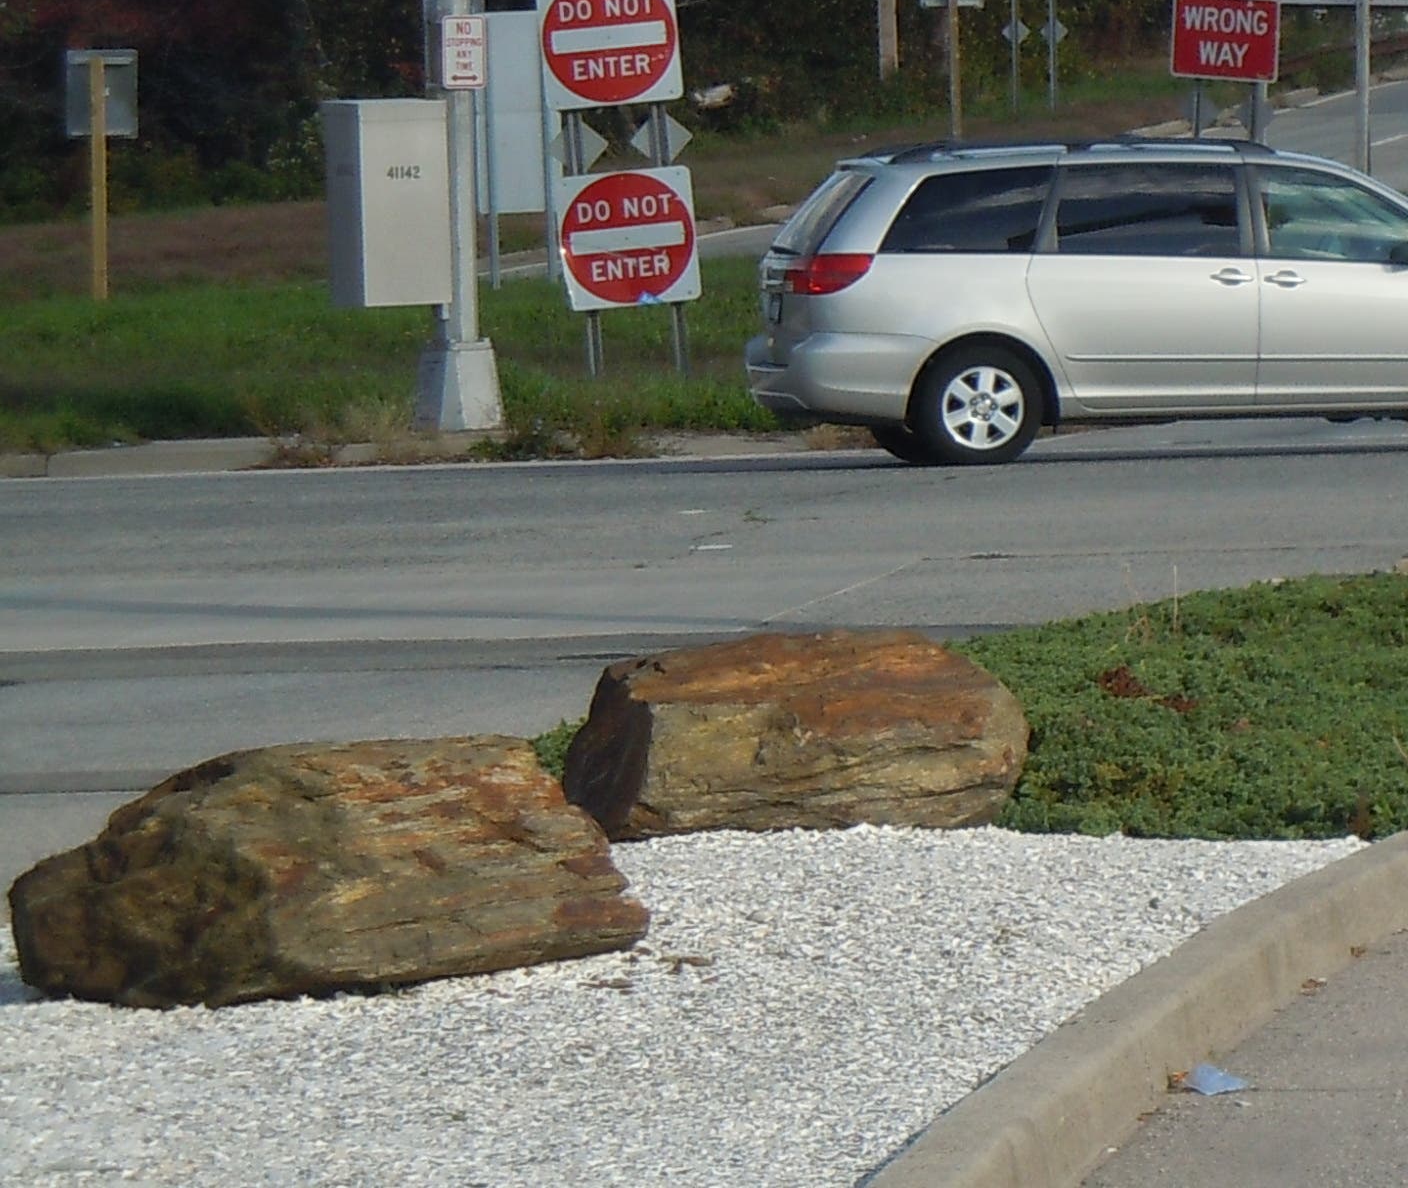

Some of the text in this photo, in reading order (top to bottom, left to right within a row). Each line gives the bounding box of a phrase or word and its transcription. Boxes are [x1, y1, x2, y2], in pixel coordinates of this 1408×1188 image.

[558, 0, 592, 22] DO
[1184, 5, 1268, 36] WRONG
[456, 21, 472, 35] NO
[456, 50, 472, 59] ANY
[573, 54, 651, 81] ENTER
[1199, 40, 1249, 68] WAY
[386, 165, 421, 180] 41142
[577, 193, 672, 224] DO NOT
[592, 254, 670, 283] ENTER
